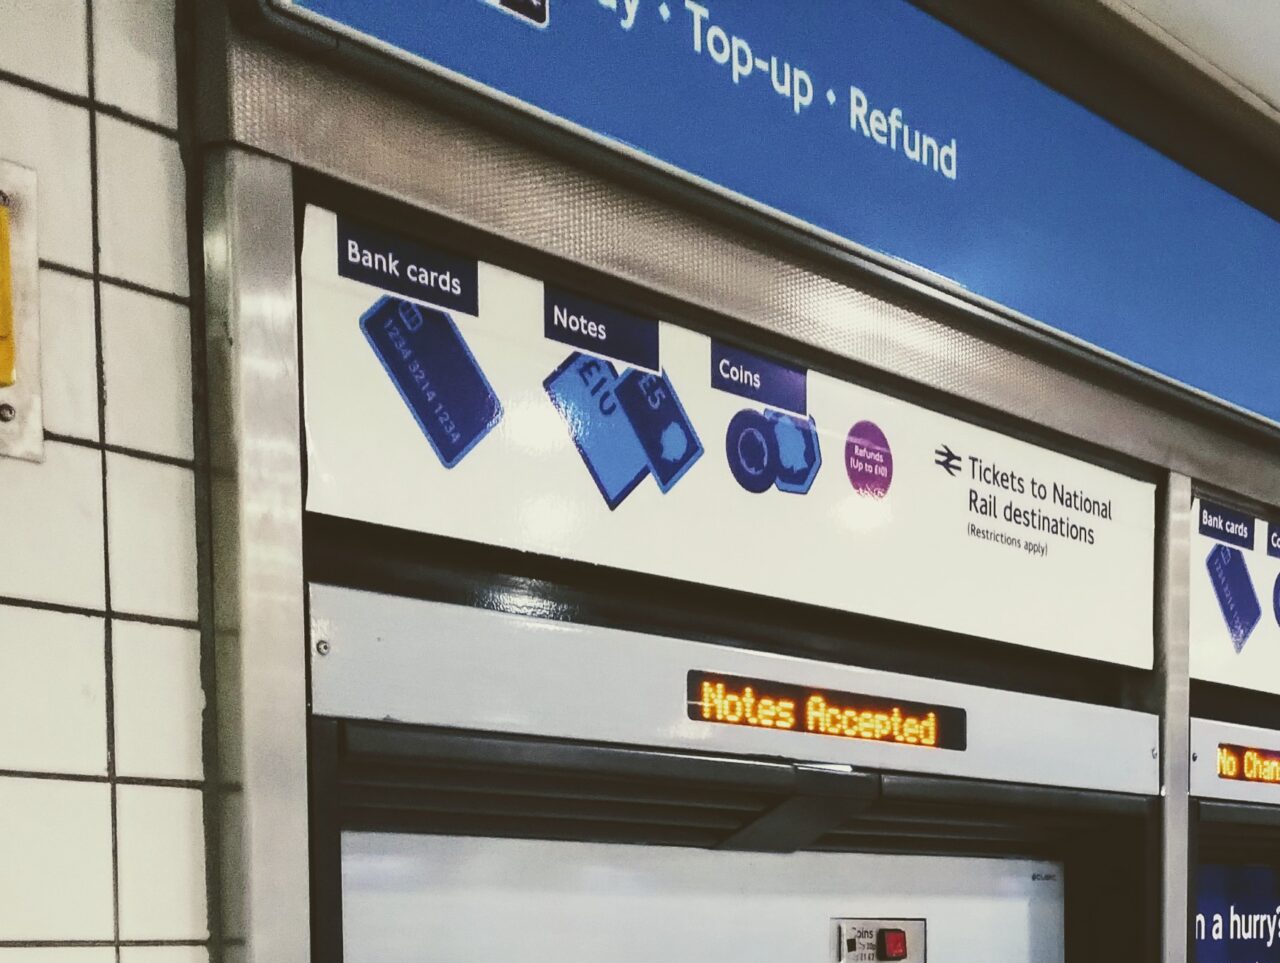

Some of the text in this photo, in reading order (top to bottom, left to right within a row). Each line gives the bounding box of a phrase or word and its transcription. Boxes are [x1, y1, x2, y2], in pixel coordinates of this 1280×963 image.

[685, 0, 813, 114] Top-up
[850, 86, 957, 180] Refund
[347, 240, 461, 295] Bank cards
[553, 305, 607, 340] Notes
[719, 359, 761, 388] Coins
[855, 444, 884, 463] Refunds
[968, 456, 1112, 520] Tickets to National
[969, 488, 1095, 545] Rail destinations
[1202, 509, 1248, 538] Bank cards
[967, 522, 1048, 557] (Restrictions apply)
[702, 681, 936, 746] Notes Accepted
[1217, 748, 1236, 777] No
[1212, 913, 1223, 940] a
